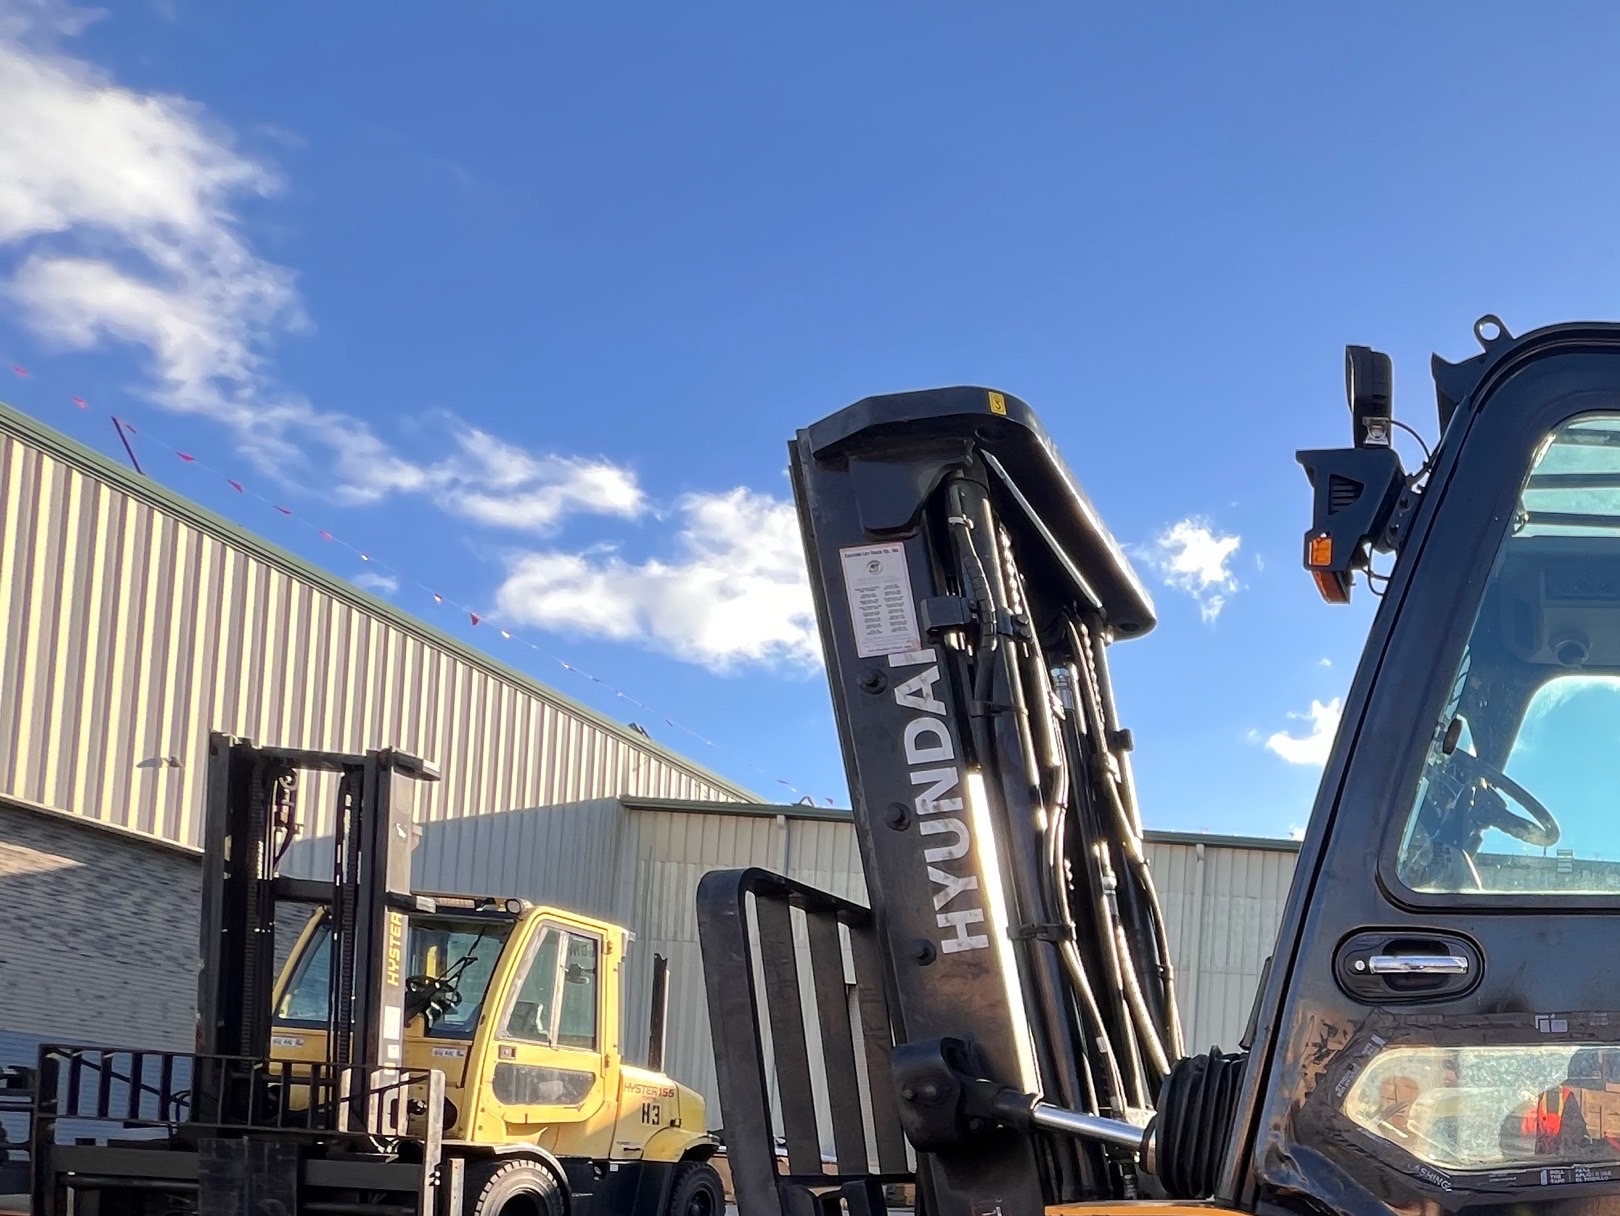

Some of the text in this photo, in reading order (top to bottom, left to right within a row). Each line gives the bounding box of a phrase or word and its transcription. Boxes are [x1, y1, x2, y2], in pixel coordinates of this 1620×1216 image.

[888, 649, 989, 954] HYUNDAI
[387, 911, 402, 987] HYSTER
[624, 1082, 658, 1096] HYSTER
[642, 1103, 660, 1125] H3
